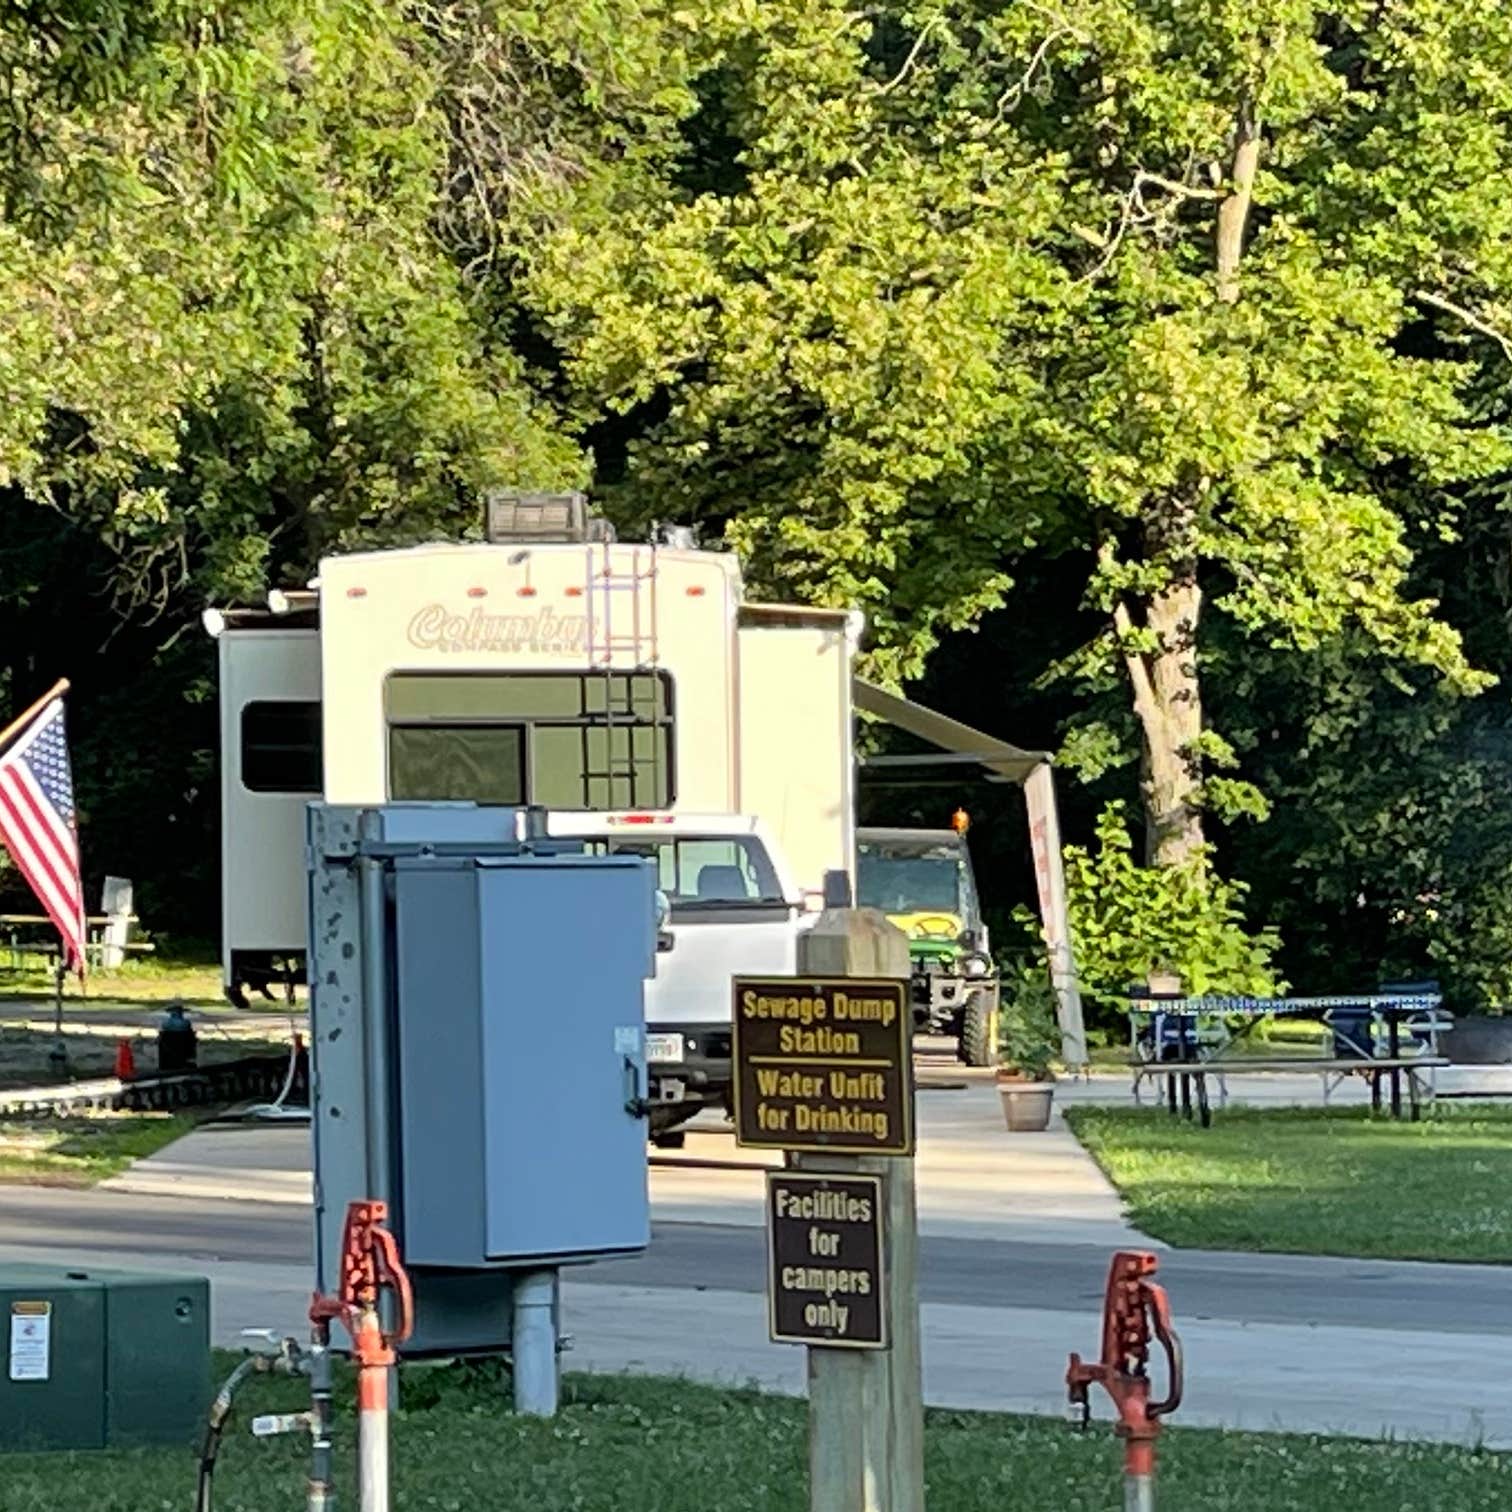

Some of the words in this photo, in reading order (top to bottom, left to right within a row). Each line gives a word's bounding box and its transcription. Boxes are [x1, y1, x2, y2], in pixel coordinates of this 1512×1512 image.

[743, 990, 826, 1025] Sewage
[833, 992, 897, 1027] Dump
[779, 1025, 860, 1054] Station
[756, 1069, 824, 1097] Water
[829, 1071, 886, 1101] Unfit
[757, 1102, 789, 1131] for
[795, 1103, 889, 1140] Drinking
[775, 1189, 872, 1223] Facilities
[809, 1226, 841, 1256] for
[782, 1267, 871, 1298] campers
[804, 1299, 849, 1335] only
